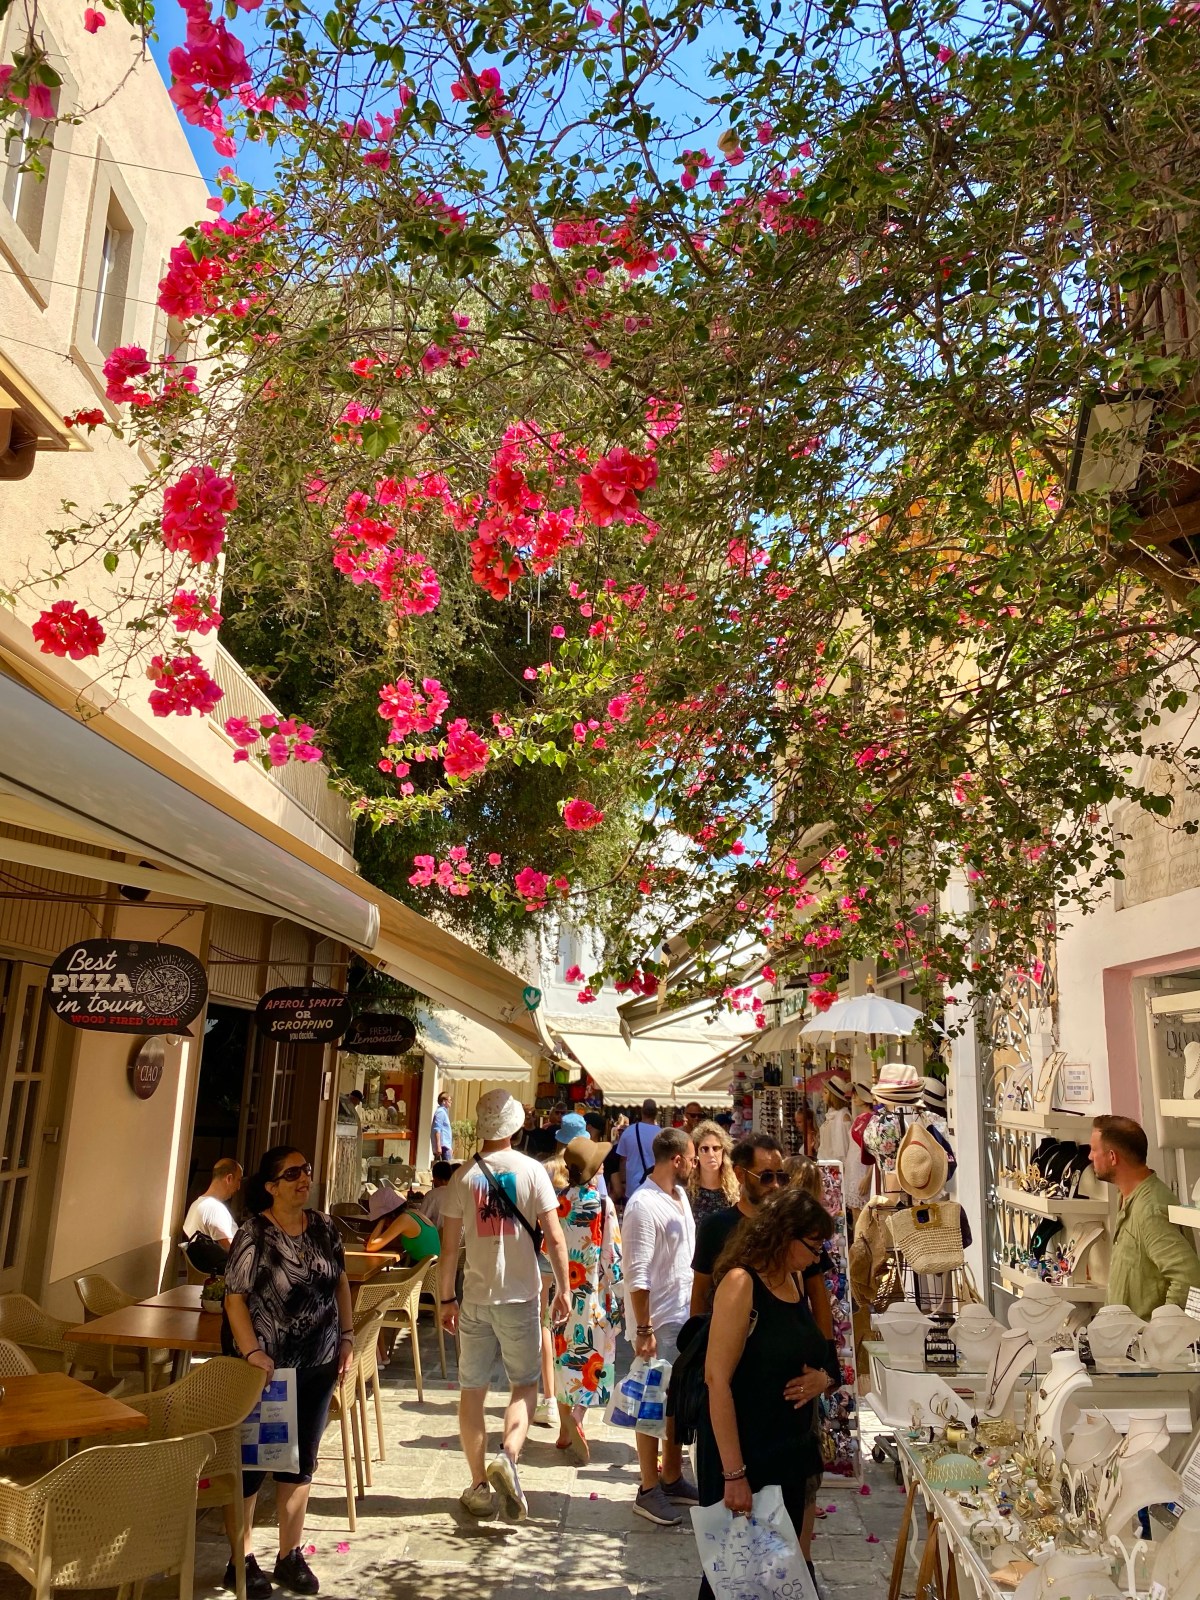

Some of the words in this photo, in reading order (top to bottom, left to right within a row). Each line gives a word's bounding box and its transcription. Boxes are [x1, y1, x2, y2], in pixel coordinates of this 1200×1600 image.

[66, 948, 118, 971] Best
[50, 973, 133, 993] PIZZA
[56, 994, 81, 1013] in
[87, 992, 146, 1013] town
[264, 999, 305, 1010] APEROL
[308, 998, 345, 1009] SPRITZ
[71, 1014, 106, 1024] WOOD
[109, 1016, 143, 1026] FIRED
[146, 1017, 178, 1026] OVEN
[295, 1010, 311, 1019] OR
[271, 1019, 334, 1032] SGROPPINO
[369, 1026, 392, 1035] FRESH
[350, 1033, 404, 1044] Lemonade
[140, 1065, 159, 1082] CIAO
[771, 1578, 803, 1600] KOS
